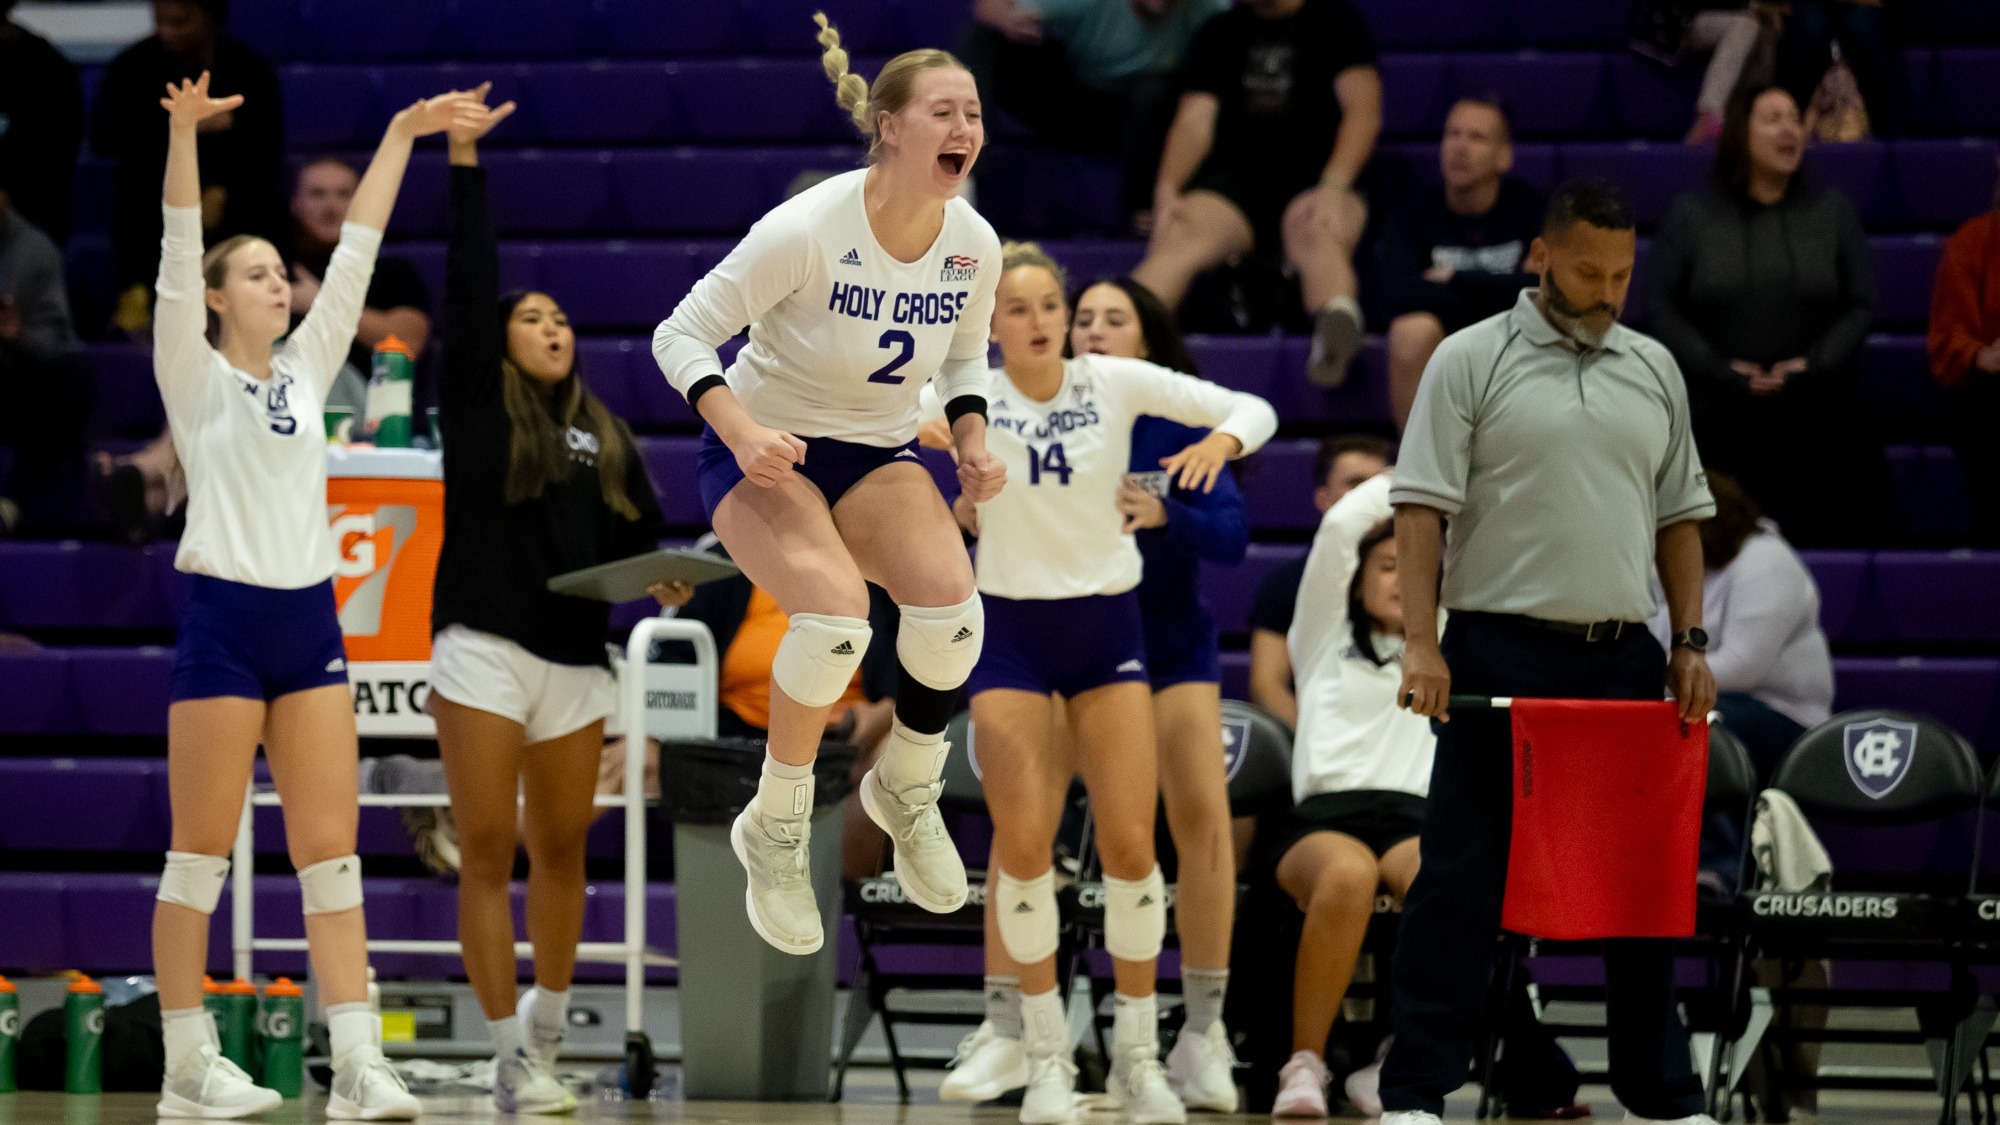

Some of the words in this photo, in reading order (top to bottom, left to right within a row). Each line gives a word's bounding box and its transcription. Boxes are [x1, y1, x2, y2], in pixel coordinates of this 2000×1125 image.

[941, 274, 976, 282] LEAGU
[828, 281, 886, 322] HOLY
[893, 291, 969, 325] CROSS
[867, 330, 916, 385] 2
[1026, 442, 1074, 486] 14
[1752, 894, 1899, 919] CRUSADERS
